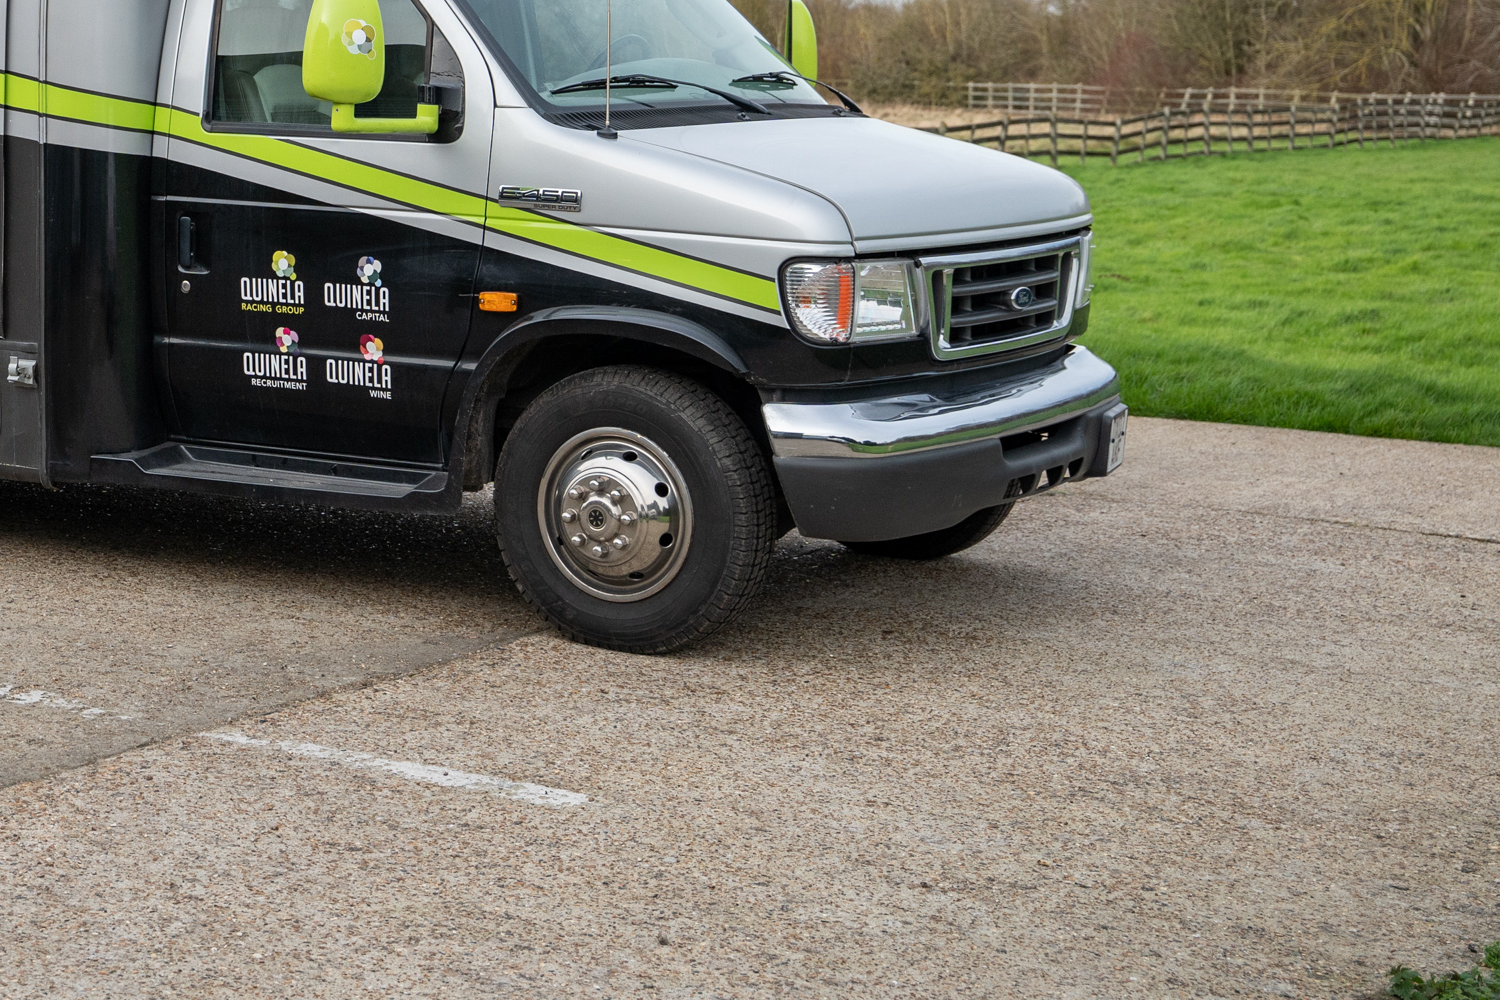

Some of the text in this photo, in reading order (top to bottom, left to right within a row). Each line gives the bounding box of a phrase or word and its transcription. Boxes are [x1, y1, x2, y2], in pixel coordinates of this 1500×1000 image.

[500, 186, 580, 204] E-450
[240, 277, 304, 304] QUINELA
[324, 282, 390, 311] QUINELA
[241, 303, 305, 315] RACING GROUP
[356, 311, 390, 323] CAPITAL
[243, 352, 307, 380] QUINELA
[326, 358, 392, 389] QUINELA
[251, 378, 307, 391] RECRUITMENT
[369, 390, 392, 400] WINE
